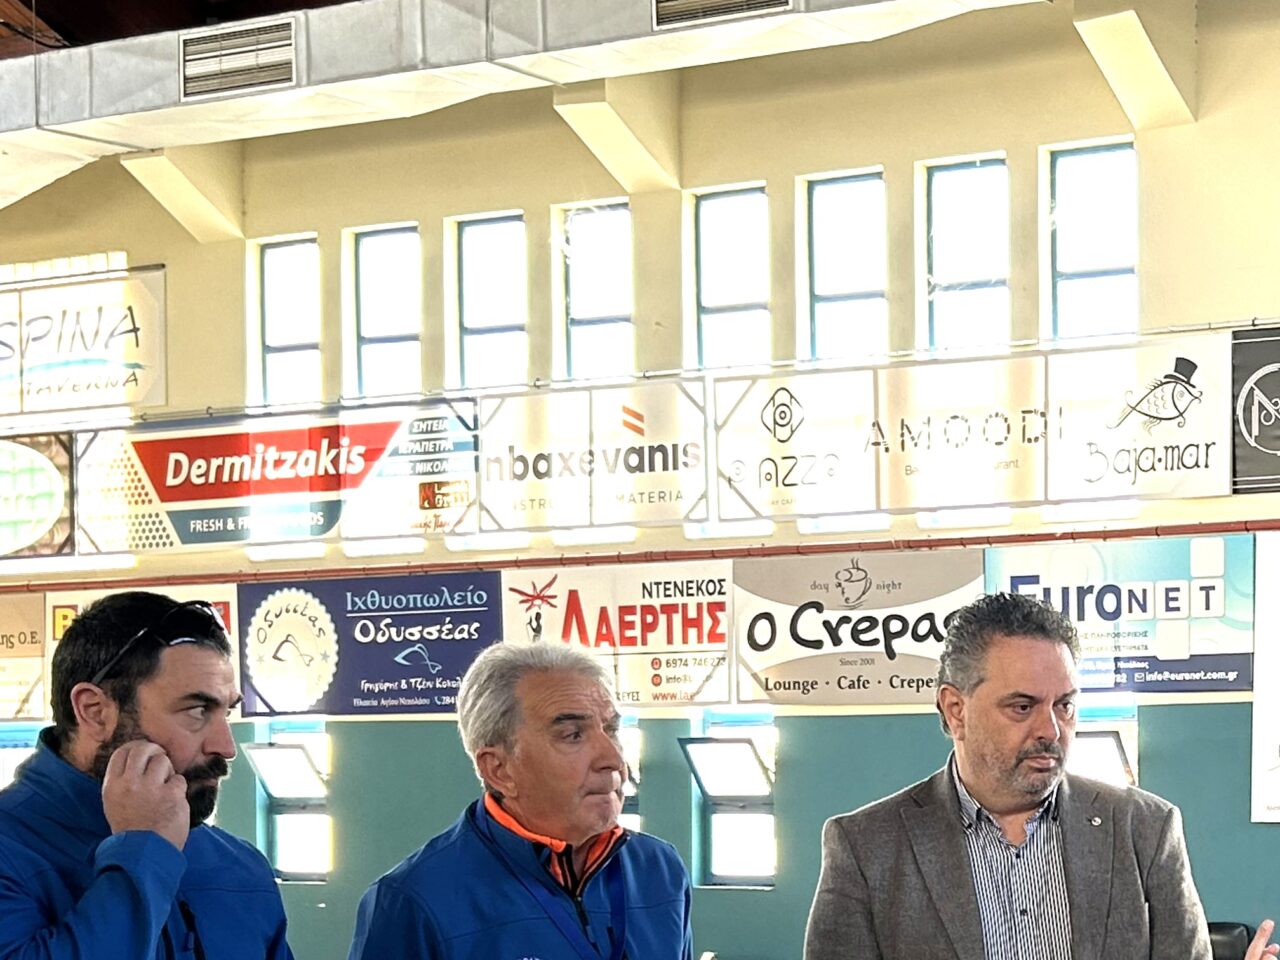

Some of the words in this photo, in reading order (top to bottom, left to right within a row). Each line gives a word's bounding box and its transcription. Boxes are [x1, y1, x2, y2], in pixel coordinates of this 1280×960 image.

[165, 437, 367, 488] Dermitzakis
[190, 519, 223, 532] FRESH
[226, 517, 235, 531] &
[642, 578, 727, 599] ΝΤΕΝΕΚΟΣ
[810, 581, 829, 592] day
[876, 580, 902, 594] night
[345, 585, 488, 612] Ιχθυοπωλείο
[561, 589, 727, 648] ΛΑΕΡΤΗΣ
[354, 617, 480, 643] Οδυσσέας
[401, 679, 407, 690] &
[765, 676, 819, 695] Lounge
[837, 675, 870, 690] Cafe
[1145, 670, 1239, 682] info@euronet.com.gr
